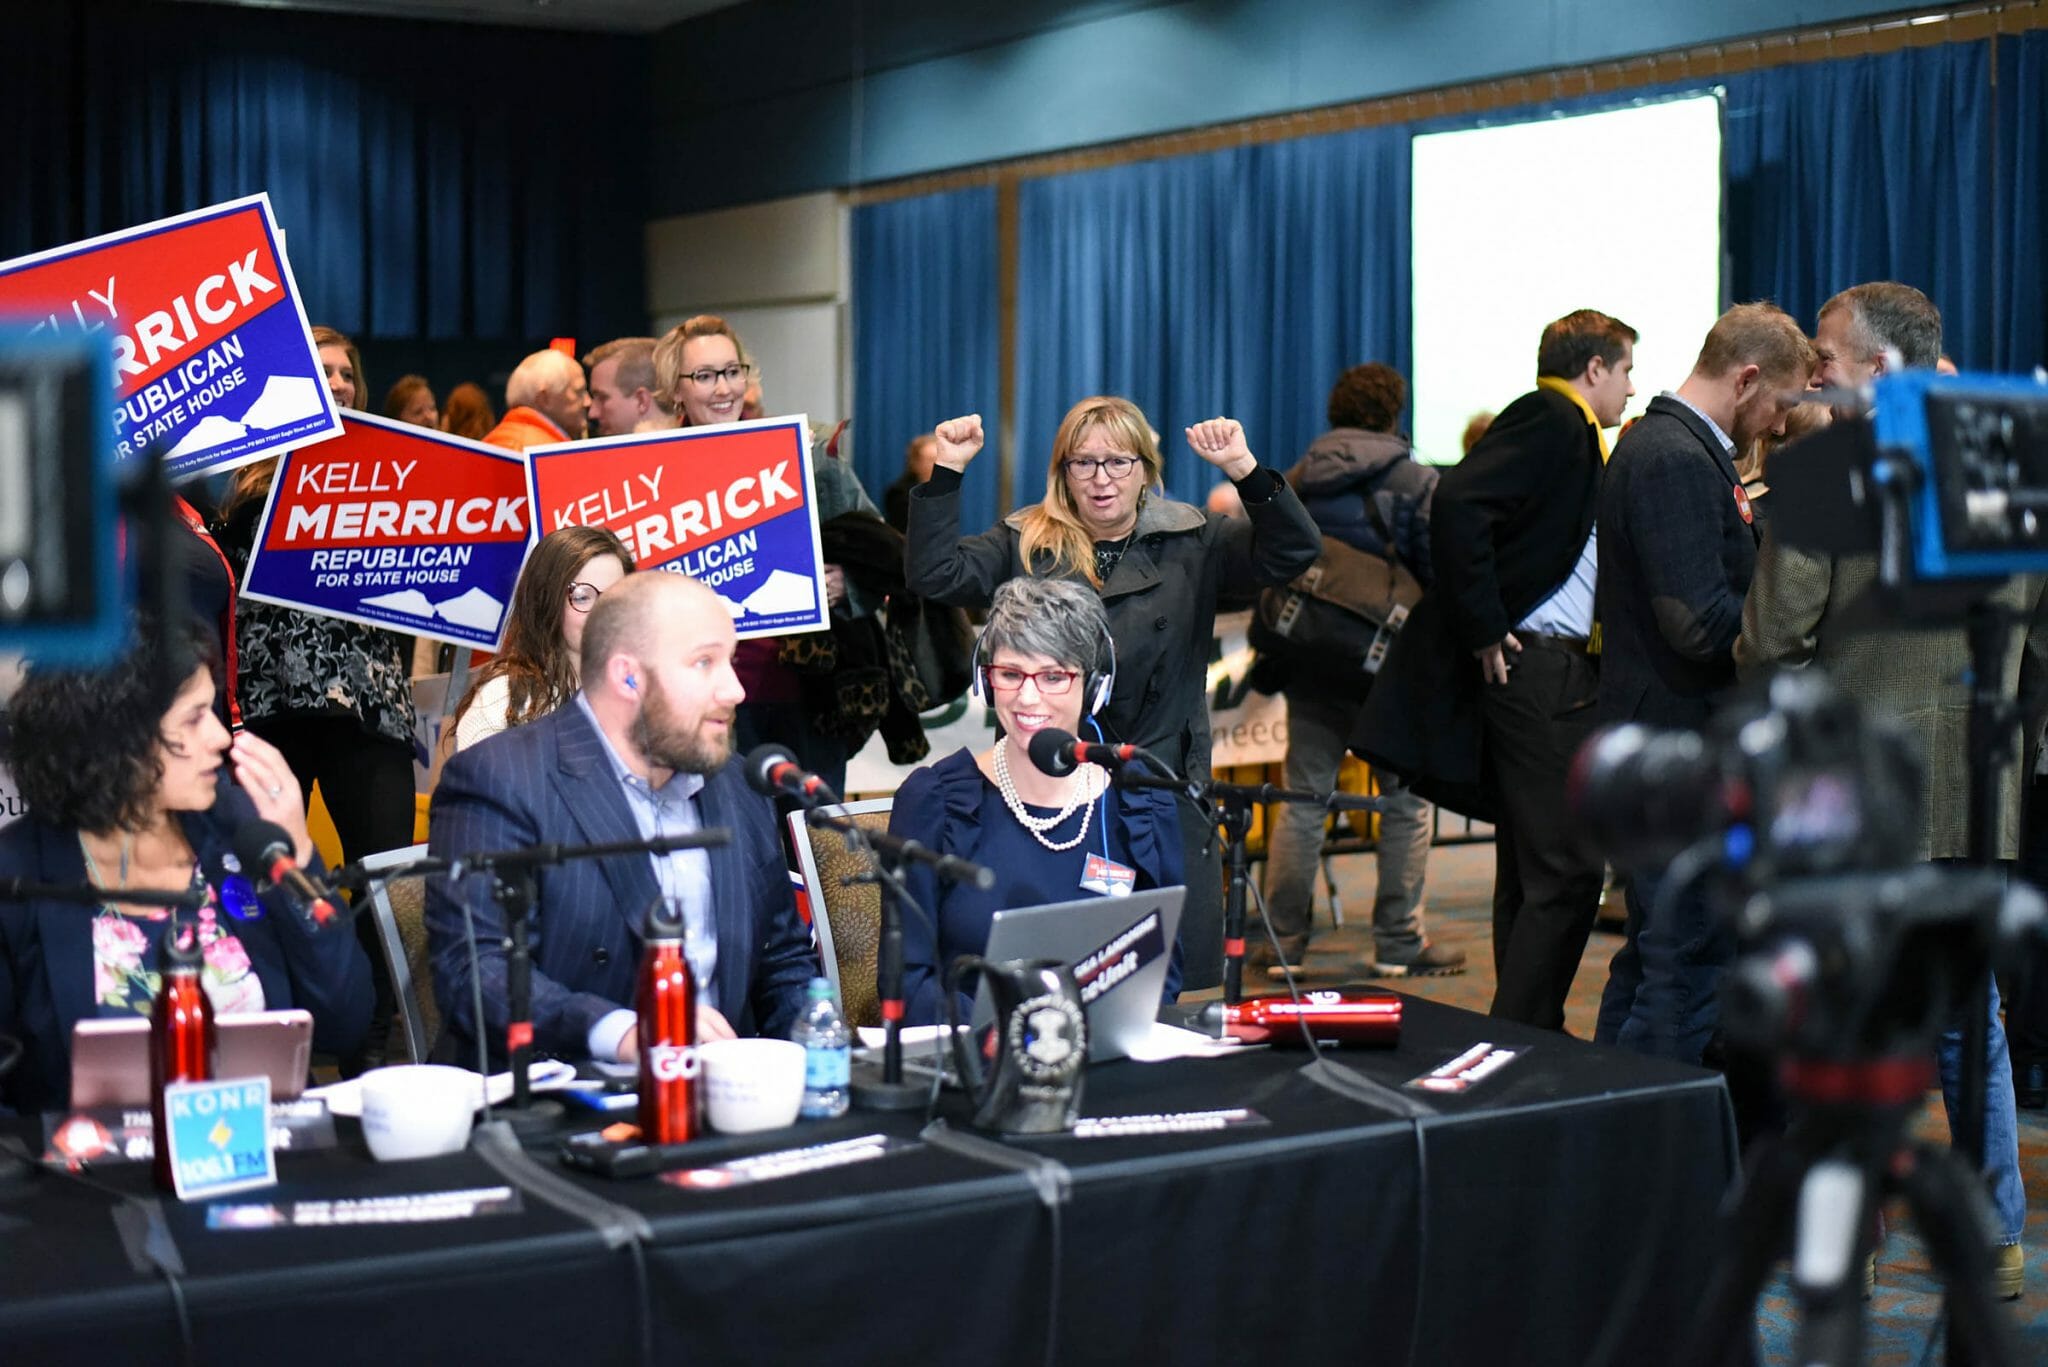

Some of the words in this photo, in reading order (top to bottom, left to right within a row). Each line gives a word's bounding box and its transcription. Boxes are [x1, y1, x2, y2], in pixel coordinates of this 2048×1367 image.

[111, 247, 278, 390] RRICK
[111, 333, 246, 436] PUBLICAN
[132, 404, 188, 448] STATE
[186, 366, 247, 415] HOUSE
[296, 459, 418, 495] KELLY
[553, 465, 664, 528] KELLY
[284, 495, 528, 541] MERRICK
[611, 460, 799, 562] RRICK
[310, 545, 472, 571] REPUBLICAN
[659, 529, 758, 577] BLICAN
[700, 557, 756, 589] HOUSE
[315, 572, 349, 588] FOR
[353, 570, 401, 586] STATE
[405, 569, 460, 585] HOUSE
[174, 1086, 263, 1117] KONR
